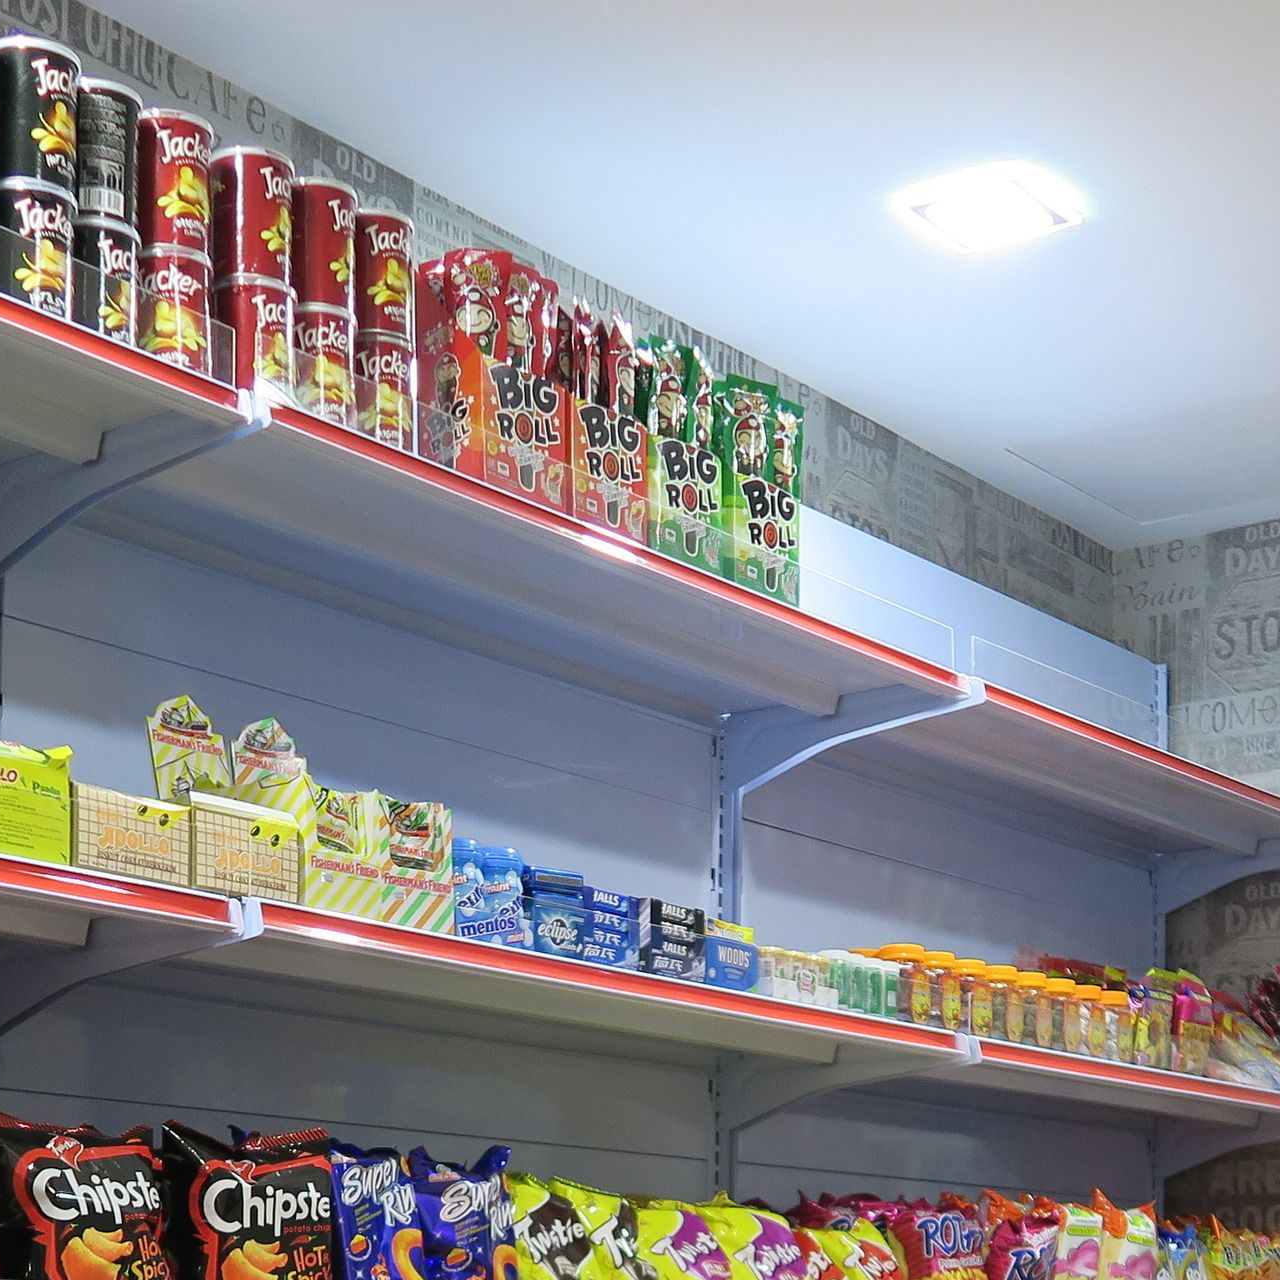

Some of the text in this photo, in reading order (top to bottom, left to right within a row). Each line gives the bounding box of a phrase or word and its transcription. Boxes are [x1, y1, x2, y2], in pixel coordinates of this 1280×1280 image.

[336, 142, 376, 184] OLD
[495, 413, 560, 447] ROLL
[587, 451, 640, 484] ROLL
[666, 482, 717, 513] ROLL
[749, 521, 796, 549] ROLL
[356, 863, 379, 879] FRIEND
[459, 916, 515, 937] mentos
[538, 921, 577, 943] eclipse
[284, 1225, 310, 1235] potato
